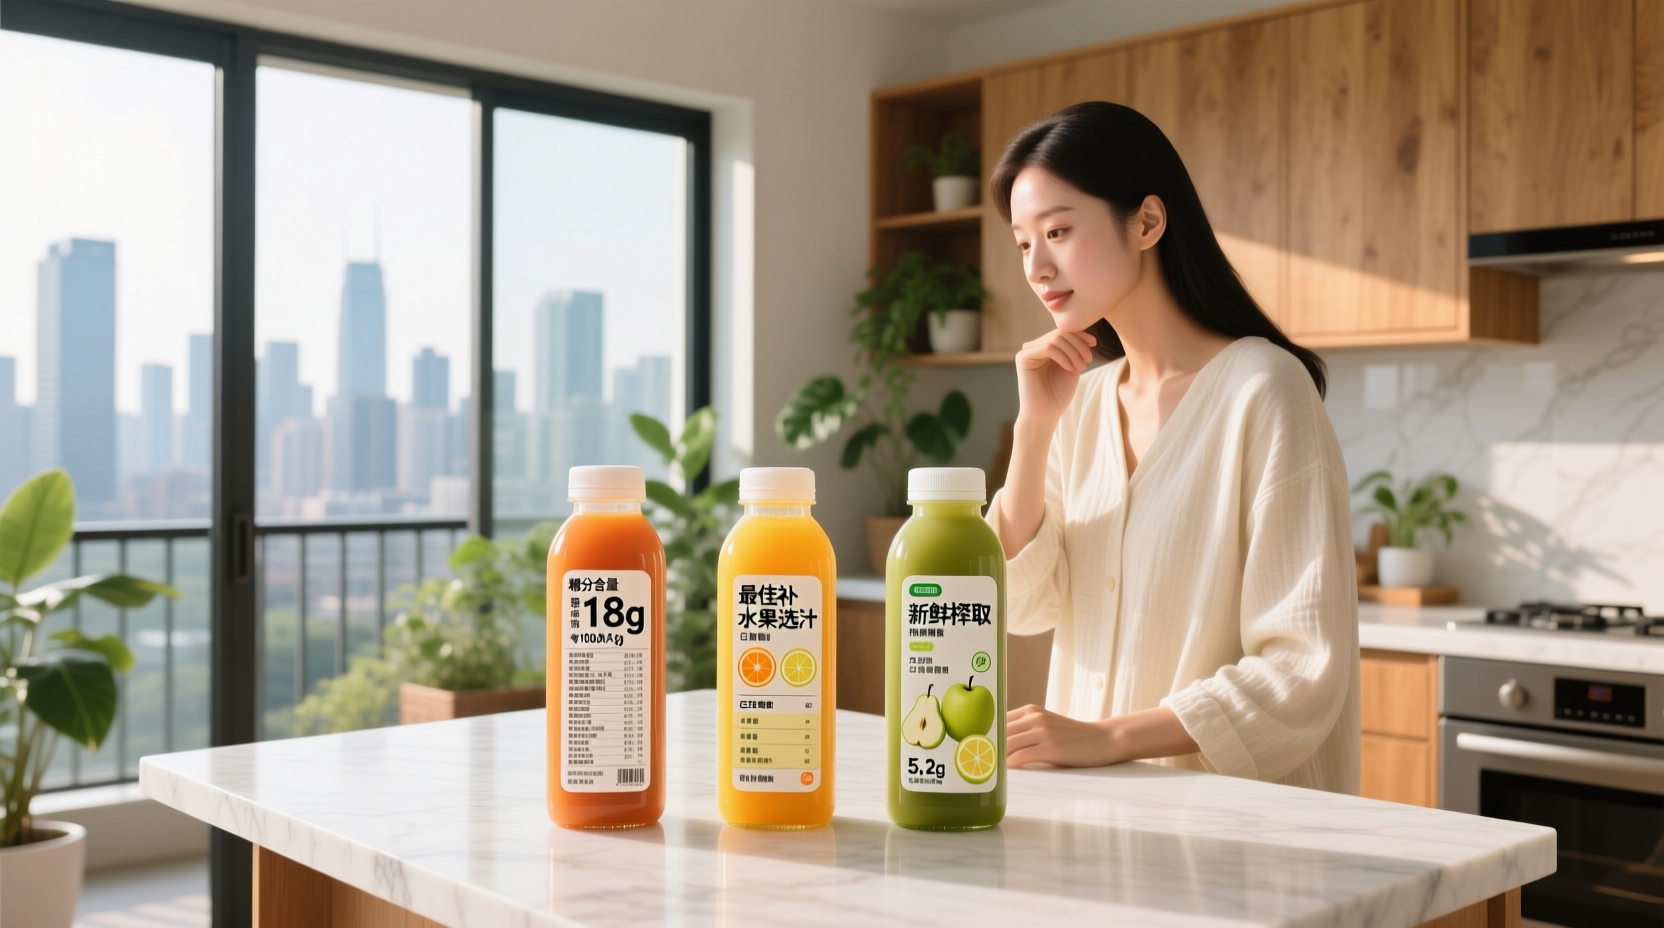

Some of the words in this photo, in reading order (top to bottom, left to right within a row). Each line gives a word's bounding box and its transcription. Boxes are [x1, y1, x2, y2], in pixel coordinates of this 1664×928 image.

[738, 583, 798, 607] 最佳补
[584, 596, 645, 635] 18g
[738, 605, 818, 630] 水果选汁
[908, 757, 945, 779] 5.2g
